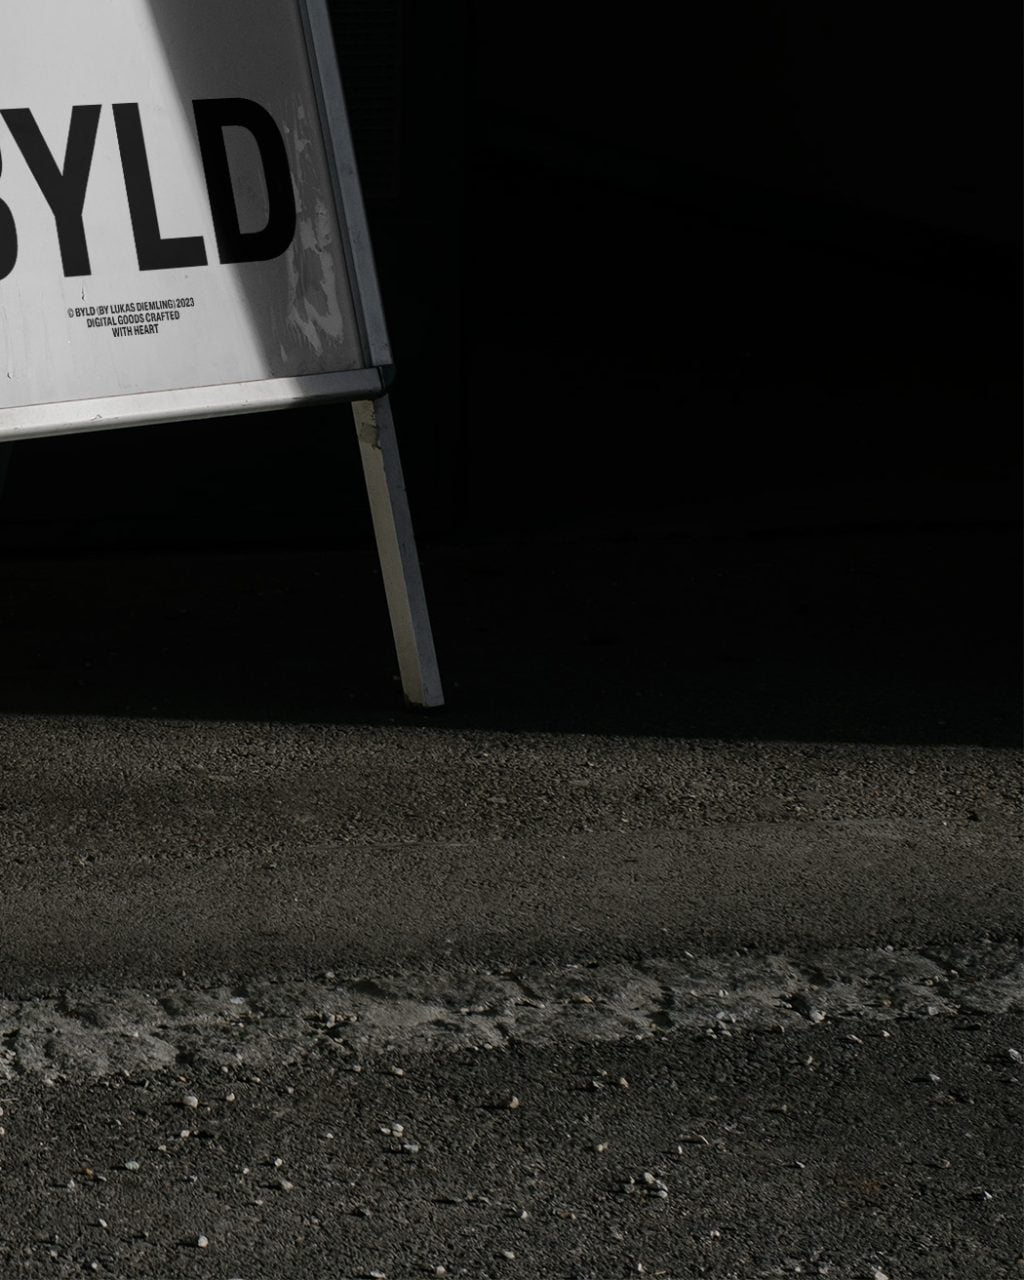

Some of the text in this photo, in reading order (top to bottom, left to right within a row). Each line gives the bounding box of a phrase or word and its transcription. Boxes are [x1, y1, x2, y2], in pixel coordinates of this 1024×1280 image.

[110, 303, 136, 314] LUKAS
[136, 299, 176, 312] DIEMLING)
[176, 297, 195, 308] 2023
[86, 310, 180, 328] DIGITAL GOODS CRAFTED
[111, 323, 159, 338] WITH HEART
